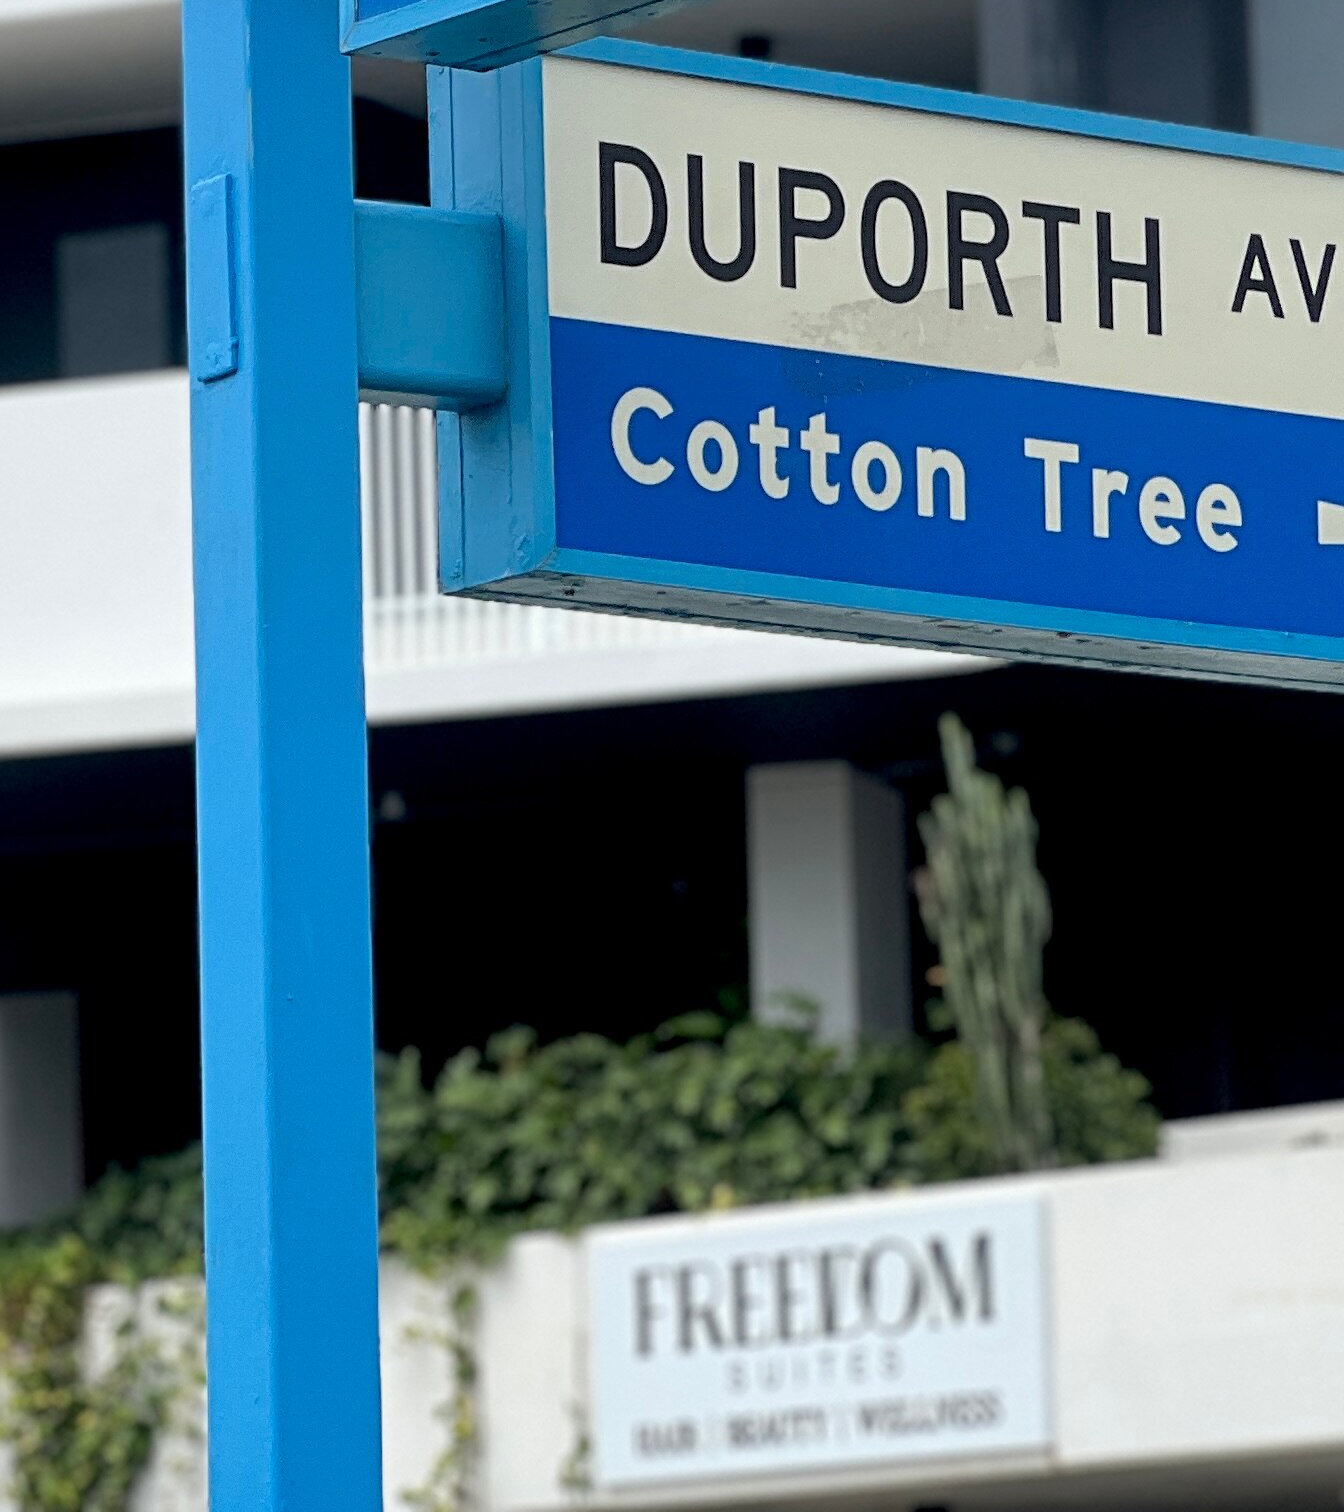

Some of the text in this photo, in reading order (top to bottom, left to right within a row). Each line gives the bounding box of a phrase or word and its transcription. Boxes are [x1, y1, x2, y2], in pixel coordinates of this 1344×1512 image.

[598, 141, 1163, 336] DUPORTH
[610, 386, 1243, 553] Cotton Tree
